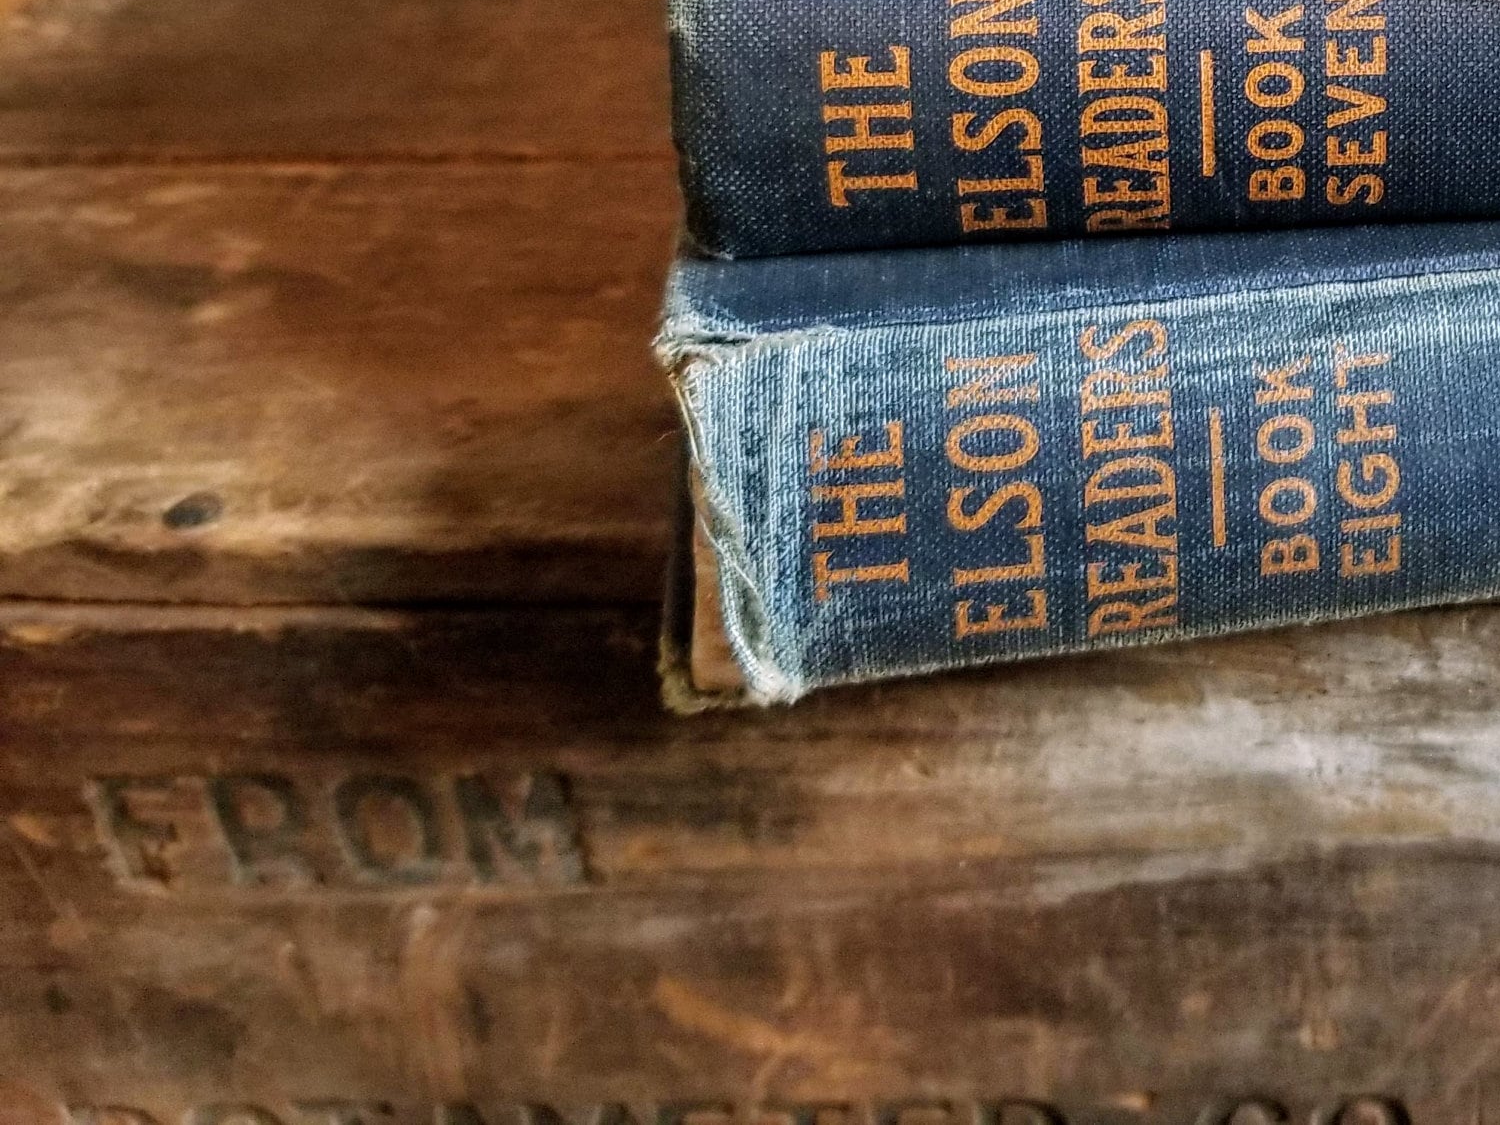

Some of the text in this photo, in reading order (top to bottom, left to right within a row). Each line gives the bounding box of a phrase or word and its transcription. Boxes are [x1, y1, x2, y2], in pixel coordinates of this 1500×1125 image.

[819, 45, 917, 208] THE
[1245, 3, 1305, 202] BOOK
[808, 420, 909, 603] THE
[945, 353, 1048, 640] ELSON
[1078, 319, 1179, 638] READERS
[1254, 356, 1321, 577] BOOK
[1335, 342, 1402, 578] EIGHT
[90, 770, 605, 893] FROM
